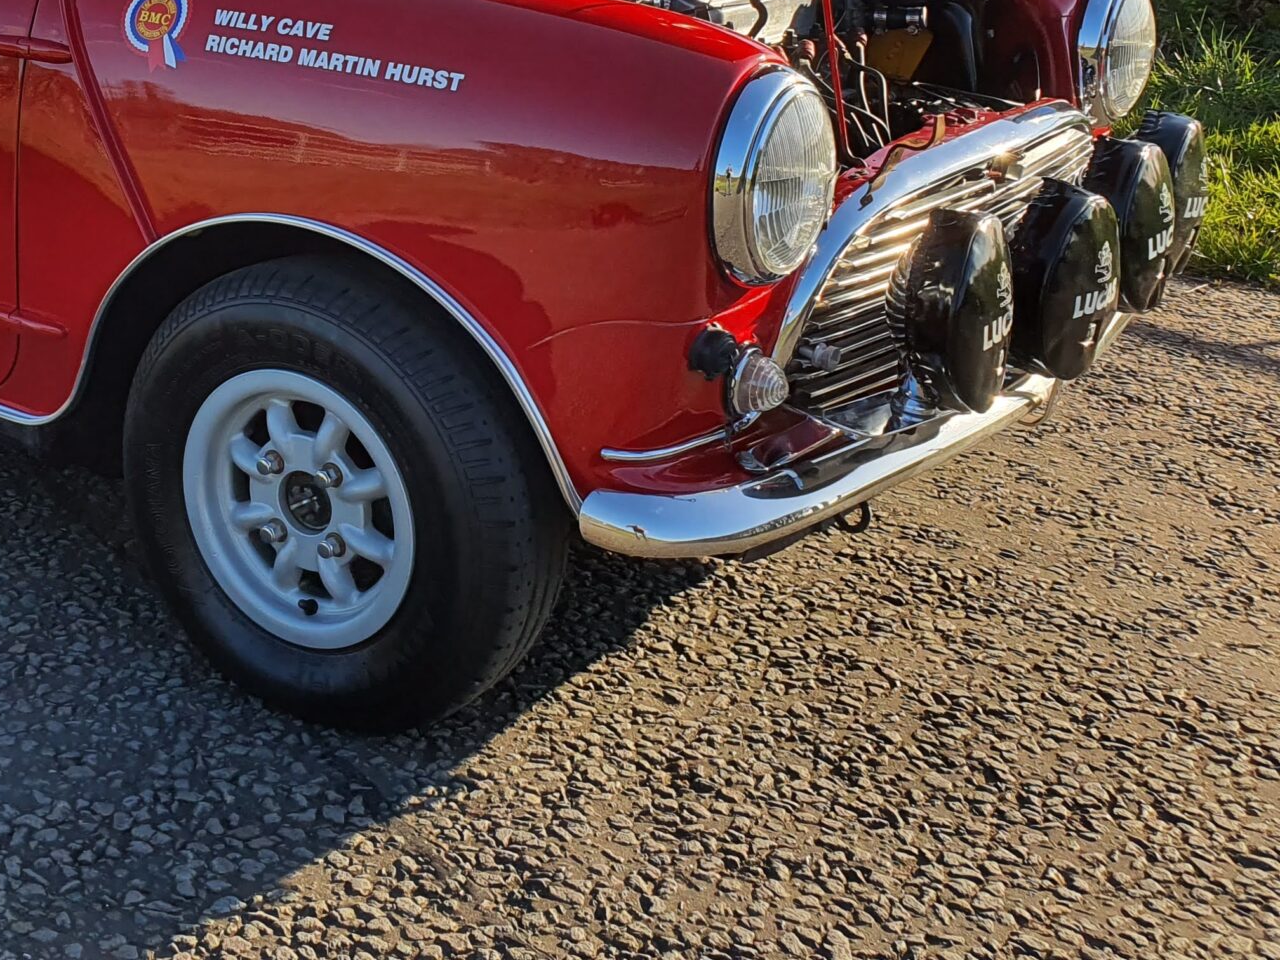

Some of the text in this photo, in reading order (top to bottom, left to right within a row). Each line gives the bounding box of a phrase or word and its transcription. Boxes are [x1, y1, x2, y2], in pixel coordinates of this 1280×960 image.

[139, 10, 171, 26] BMC
[214, 8, 333, 41] WILLY CAVE
[205, 34, 465, 91] RICHARD MARTIN HURST
[1184, 195, 1209, 219] LUC
[1147, 224, 1175, 261] LUC
[982, 309, 1014, 352] LUC
